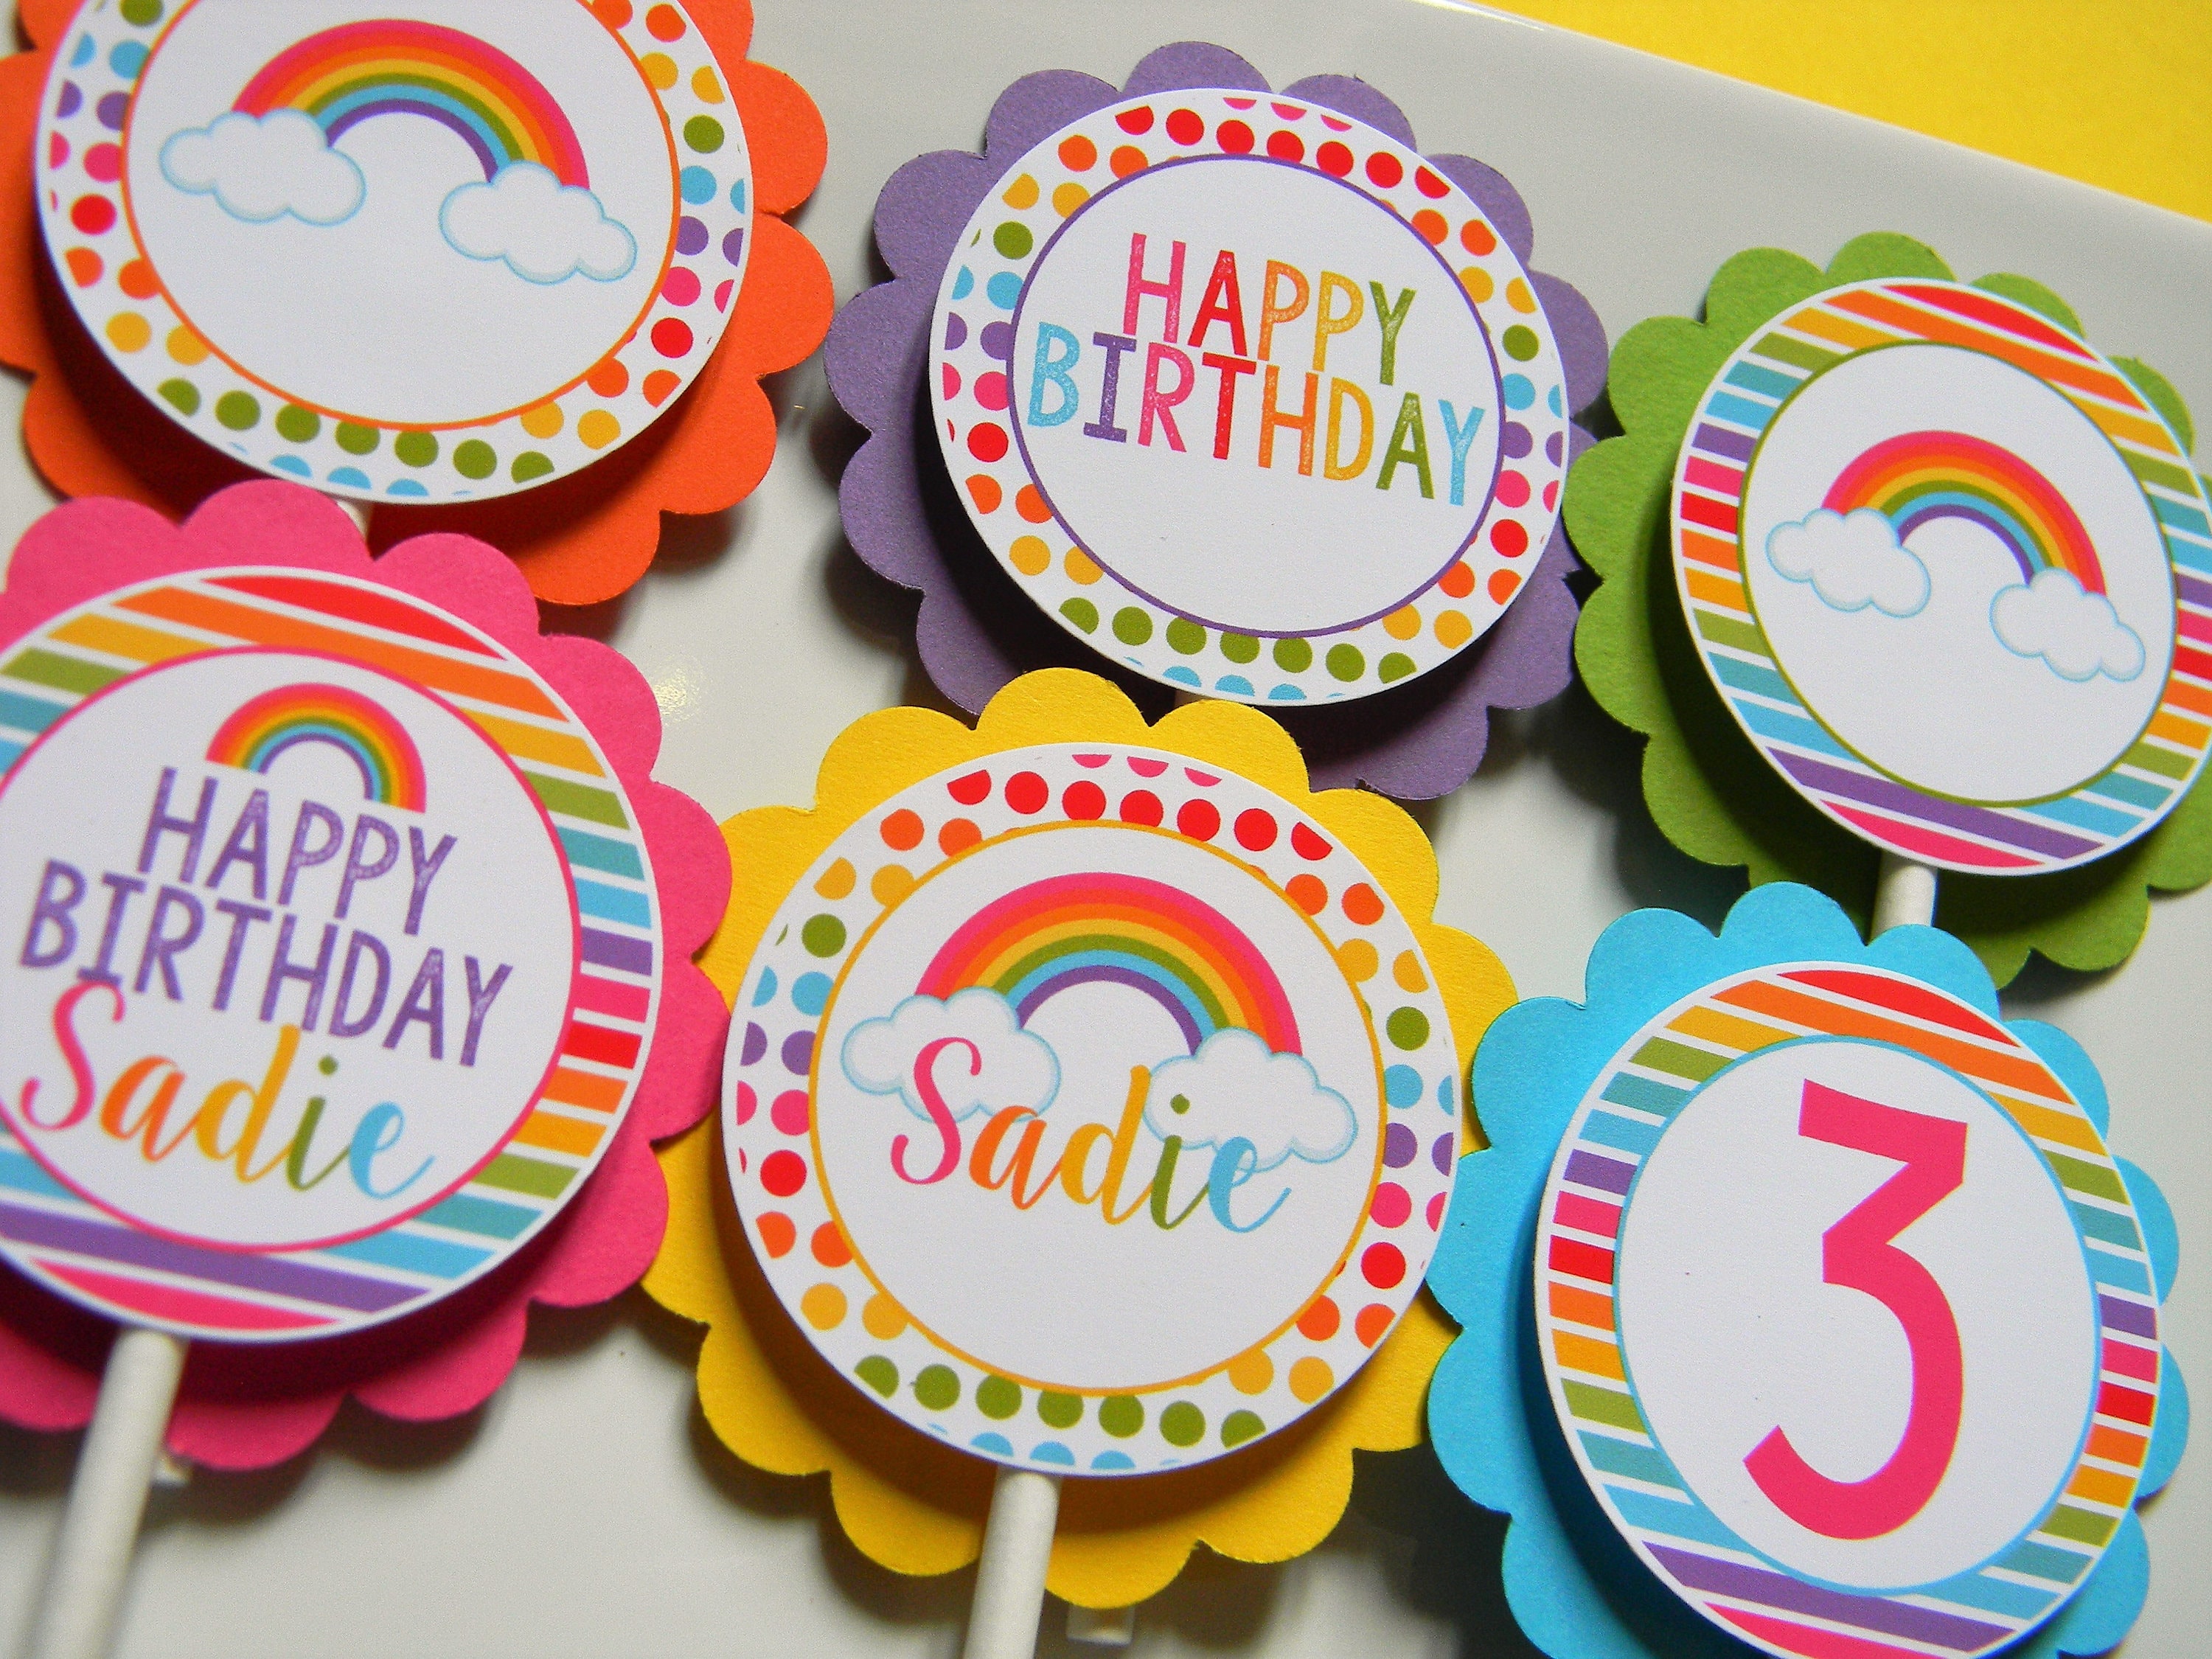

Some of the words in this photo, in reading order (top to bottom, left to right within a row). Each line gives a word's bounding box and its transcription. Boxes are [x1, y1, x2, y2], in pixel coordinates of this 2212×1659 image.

[1123, 232, 1416, 386] HAPPY
[1026, 321, 1485, 506] BIRTHDAY
[137, 766, 458, 936] HAPPY
[19, 859, 514, 1068] BIRTHDAY
[19, 980, 436, 1200] Sadie
[890, 1037, 1292, 1233] Sadie
[1743, 1078, 1967, 1540] 3
